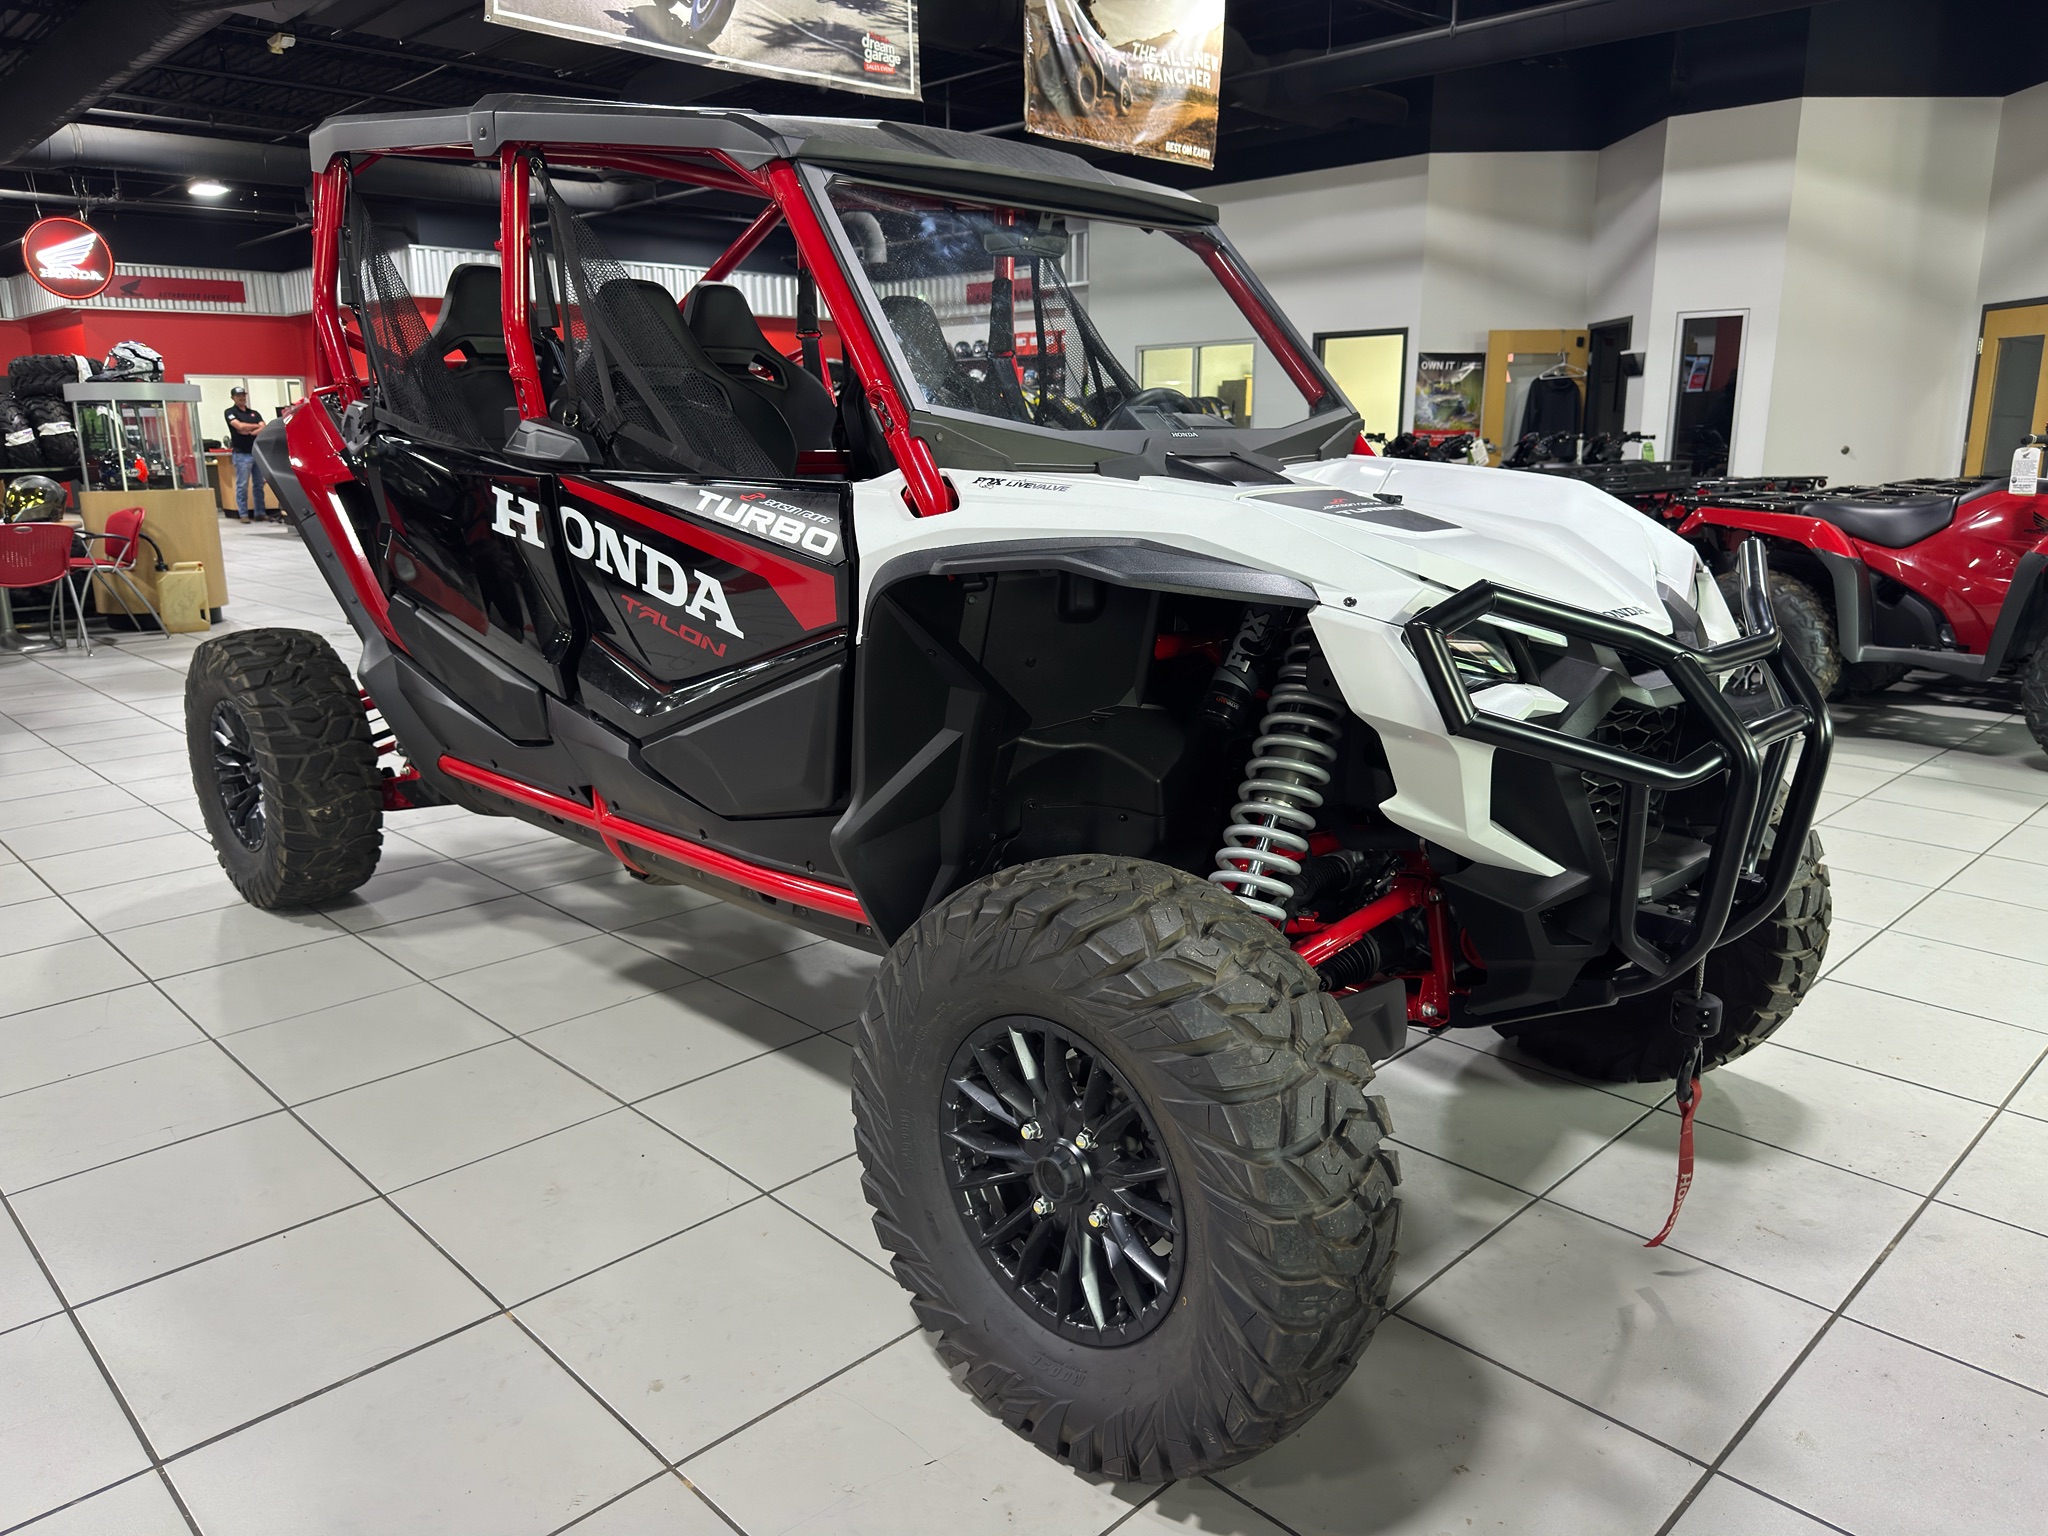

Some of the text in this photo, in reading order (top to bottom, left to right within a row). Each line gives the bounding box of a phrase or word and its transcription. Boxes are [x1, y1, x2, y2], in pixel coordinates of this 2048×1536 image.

[862, 32, 895, 55] dream
[864, 48, 901, 67] garage
[1132, 42, 1219, 73] THE ALL-NEW
[1143, 63, 1211, 89] RANCHER
[1165, 141, 1211, 160] BEST ON EARTH
[39, 267, 105, 281] HONDA
[1421, 361, 1443, 371] OWN
[1445, 361, 1456, 371] IT
[1171, 431, 1199, 439] HONDA
[696, 489, 839, 557] TURBO
[491, 485, 744, 640] HONDA
[1602, 605, 1651, 619] ONDA
[621, 594, 727, 658] TALON
[1223, 609, 1271, 673] FOX
